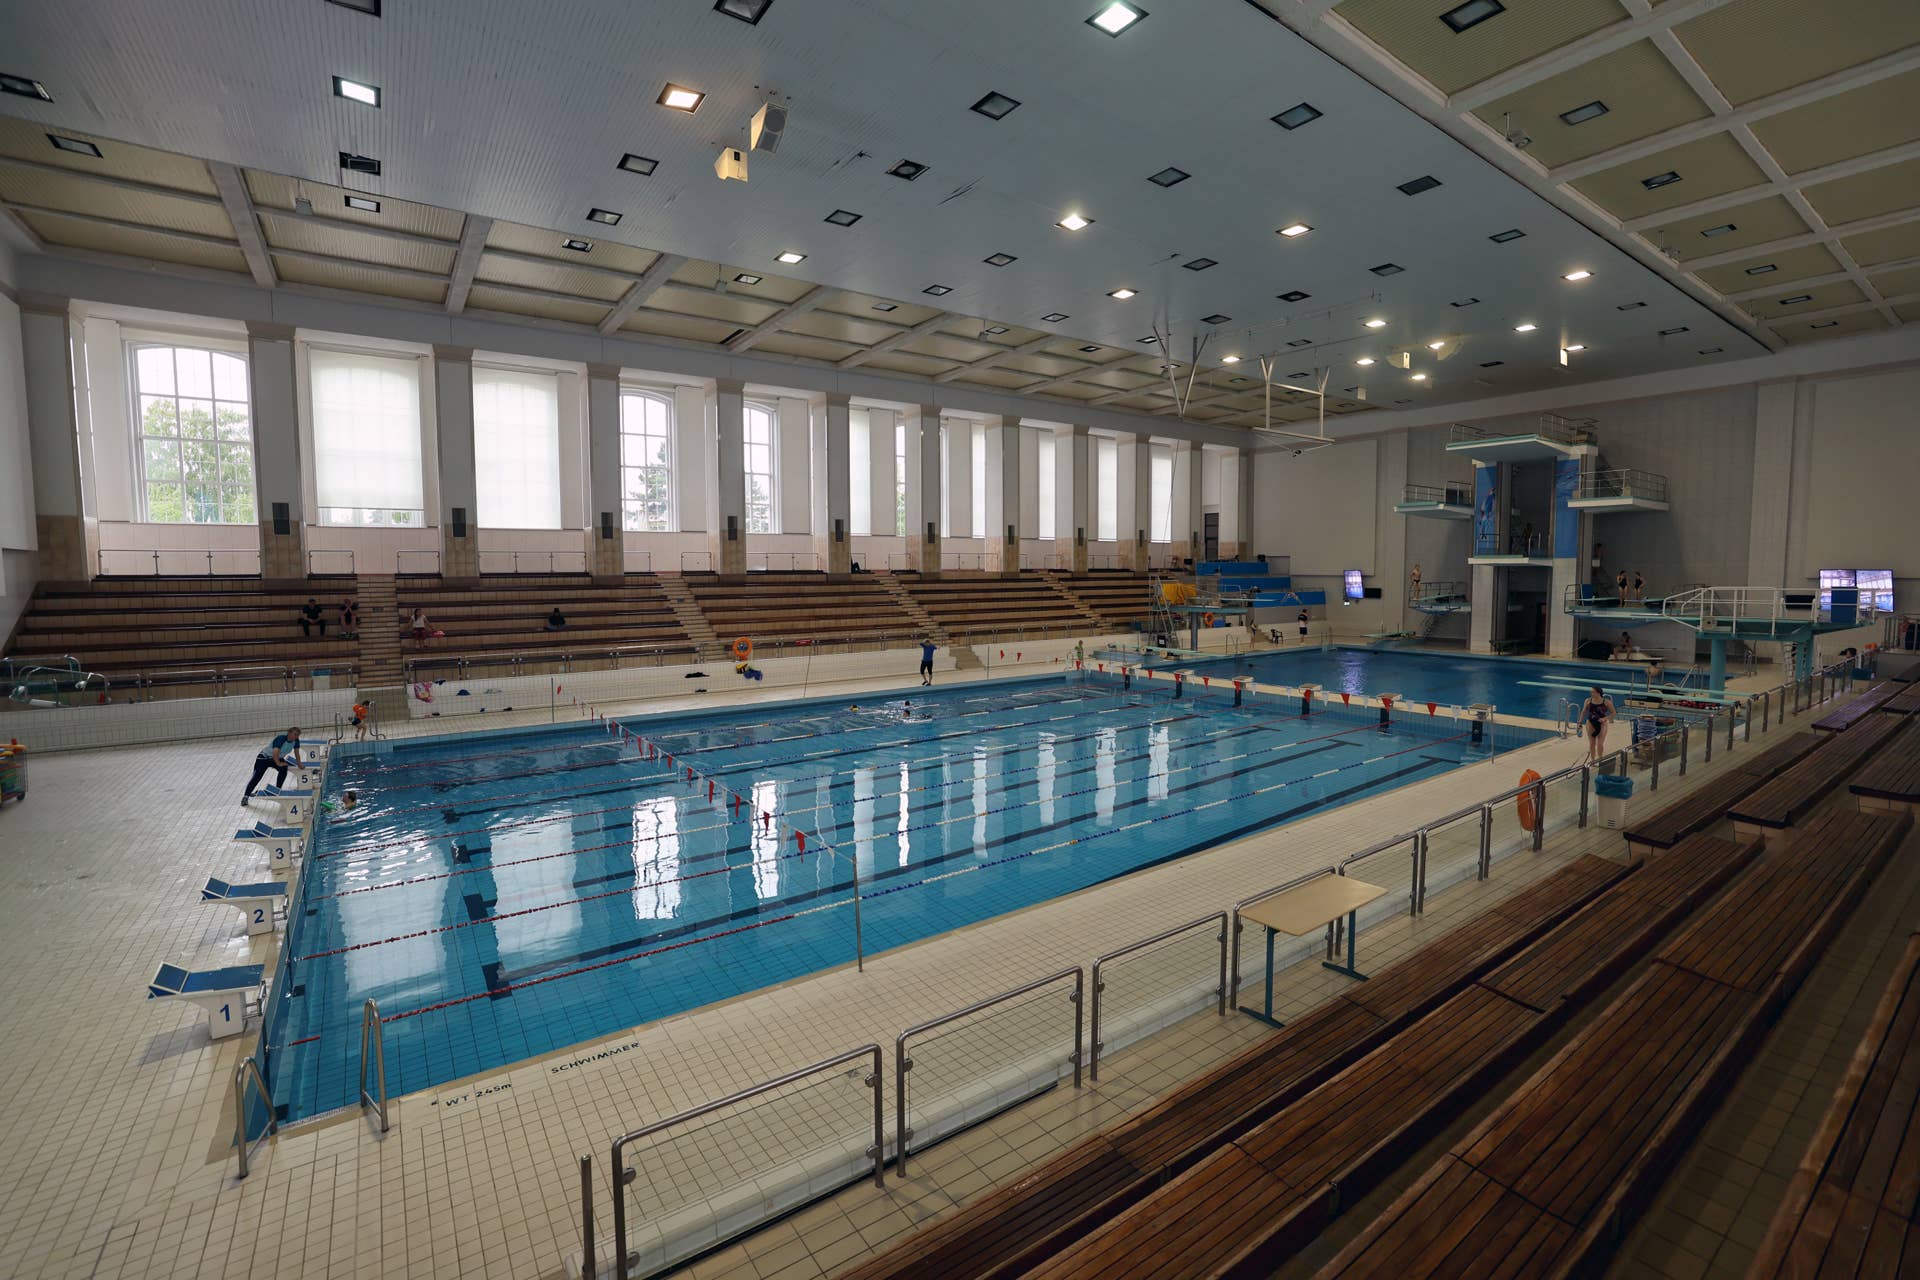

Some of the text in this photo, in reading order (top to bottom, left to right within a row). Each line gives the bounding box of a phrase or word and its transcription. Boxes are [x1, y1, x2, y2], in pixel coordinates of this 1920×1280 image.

[310, 751, 316, 759] 6
[301, 775, 308, 784] 5
[290, 805, 298, 815] 4
[275, 848, 284, 860] 3
[253, 909, 265, 924] 2
[219, 1004, 230, 1022] 1
[551, 1042, 639, 1074] SCHWIMMER
